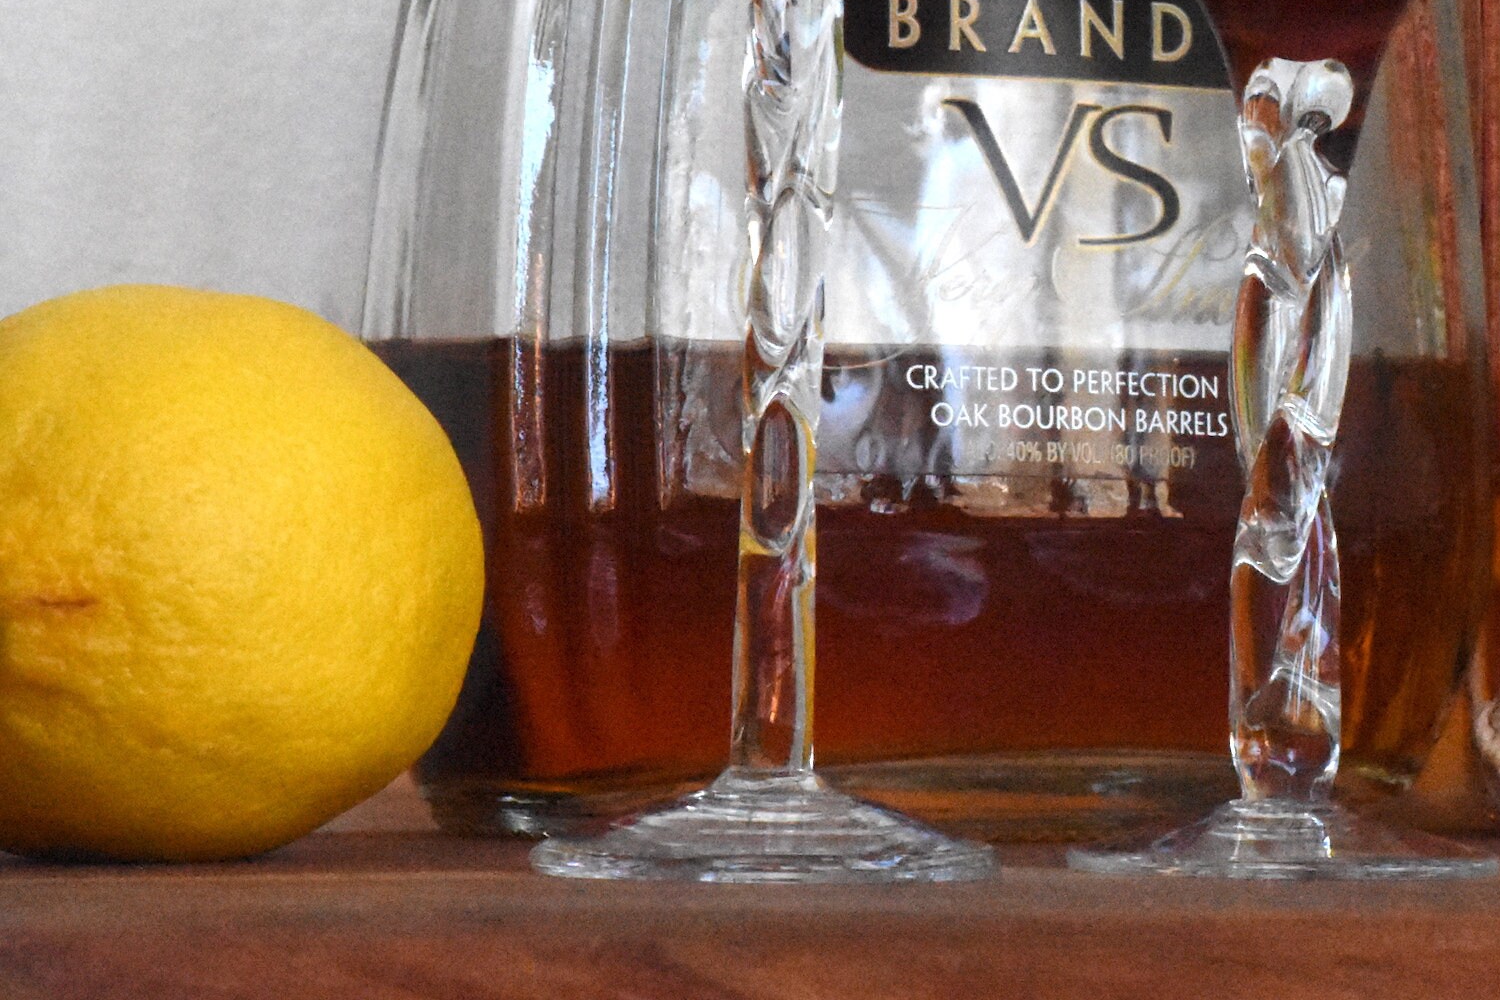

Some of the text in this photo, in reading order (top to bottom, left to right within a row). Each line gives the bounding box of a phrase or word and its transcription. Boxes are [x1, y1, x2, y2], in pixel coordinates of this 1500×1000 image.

[942, 98, 1180, 246] VS
[905, 364, 1219, 399] CRAFTED TO PERFECTION
[930, 402, 1228, 437] OAK BOURBON BARRELS
[1006, 442, 1042, 463] 40%
[1047, 442, 1069, 463] BY
